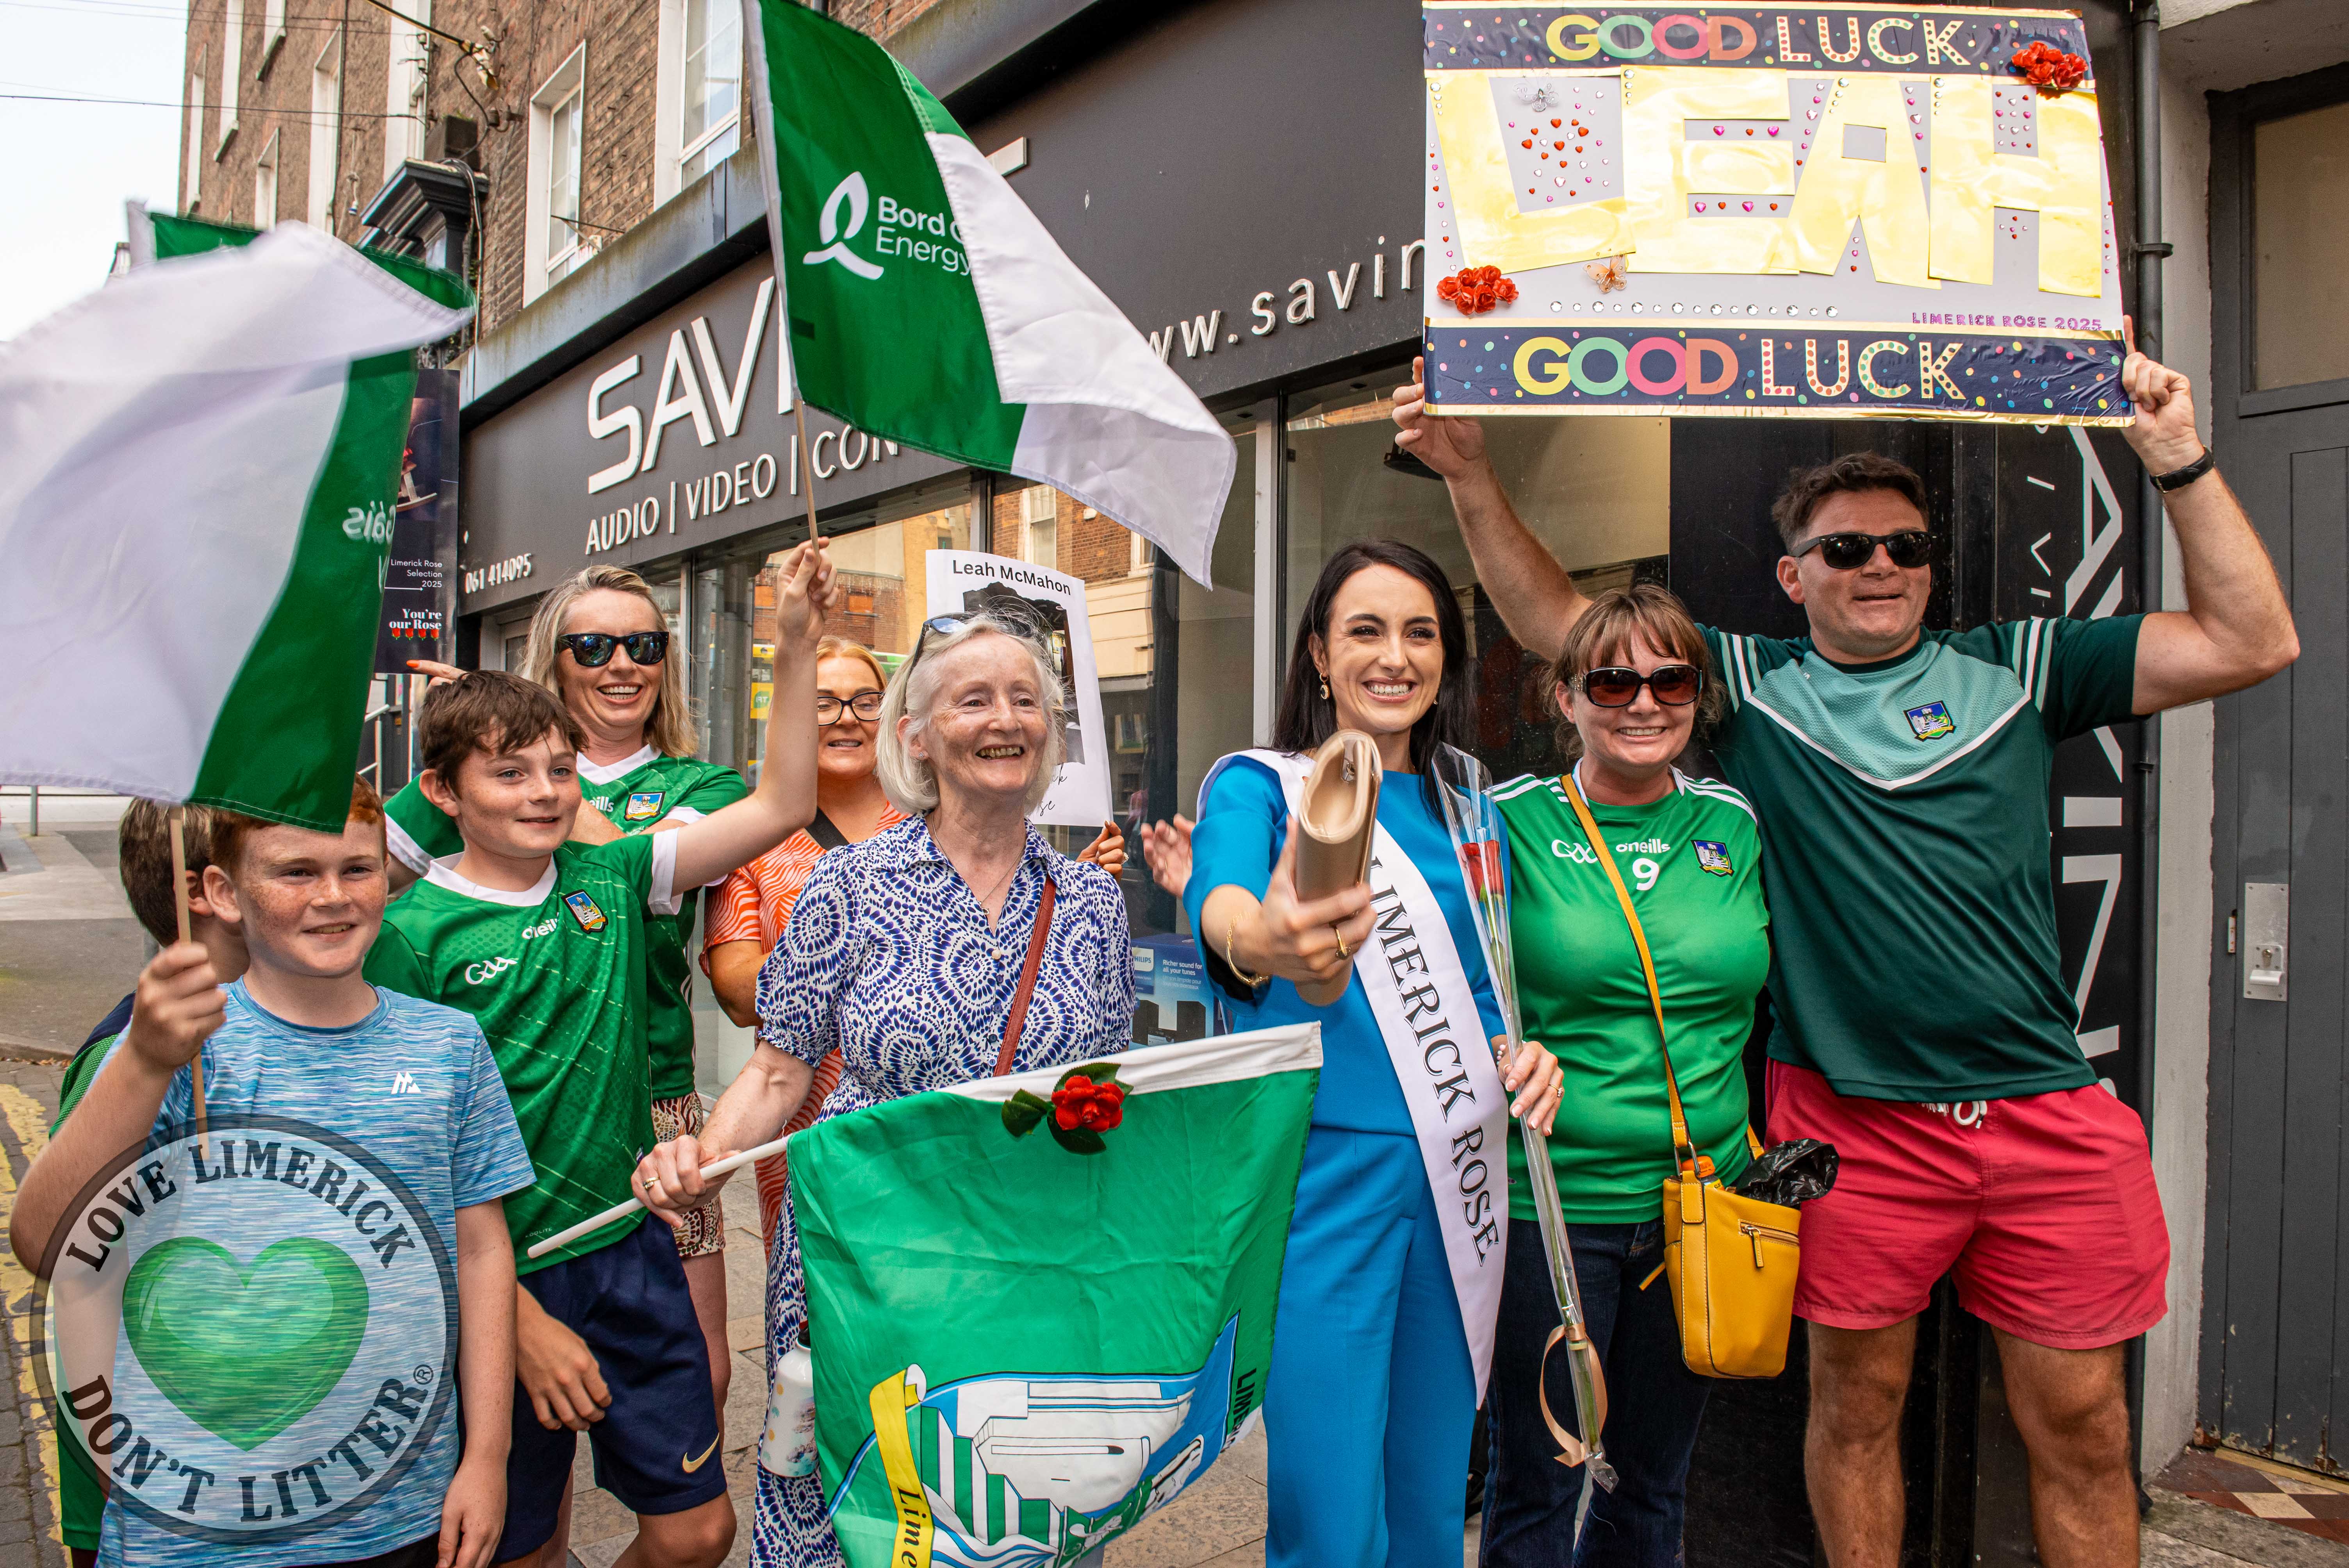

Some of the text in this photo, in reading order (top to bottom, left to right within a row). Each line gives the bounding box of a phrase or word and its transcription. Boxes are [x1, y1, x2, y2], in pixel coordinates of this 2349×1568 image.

[1546, 15, 1971, 66] GOOD LUCK
[1426, 64, 2101, 298] LEAH
[879, 196, 945, 237] Bord
[876, 226, 971, 276] Energy
[1912, 312, 2102, 331] LIMERICK ROSE 2025
[1513, 336, 1966, 400] GOOD LUCK
[585, 497, 660, 554] AUDIO
[686, 453, 777, 520] VIDEO
[407, 569, 442, 577] Selection
[465, 553, 531, 593] 061 414095
[952, 559, 1071, 596] Leah McMahon
[402, 608, 442, 619] You're
[413, 619, 442, 629] Rose
[1632, 858, 1659, 891] 9
[1451, 1124, 1499, 1267] ROSE
